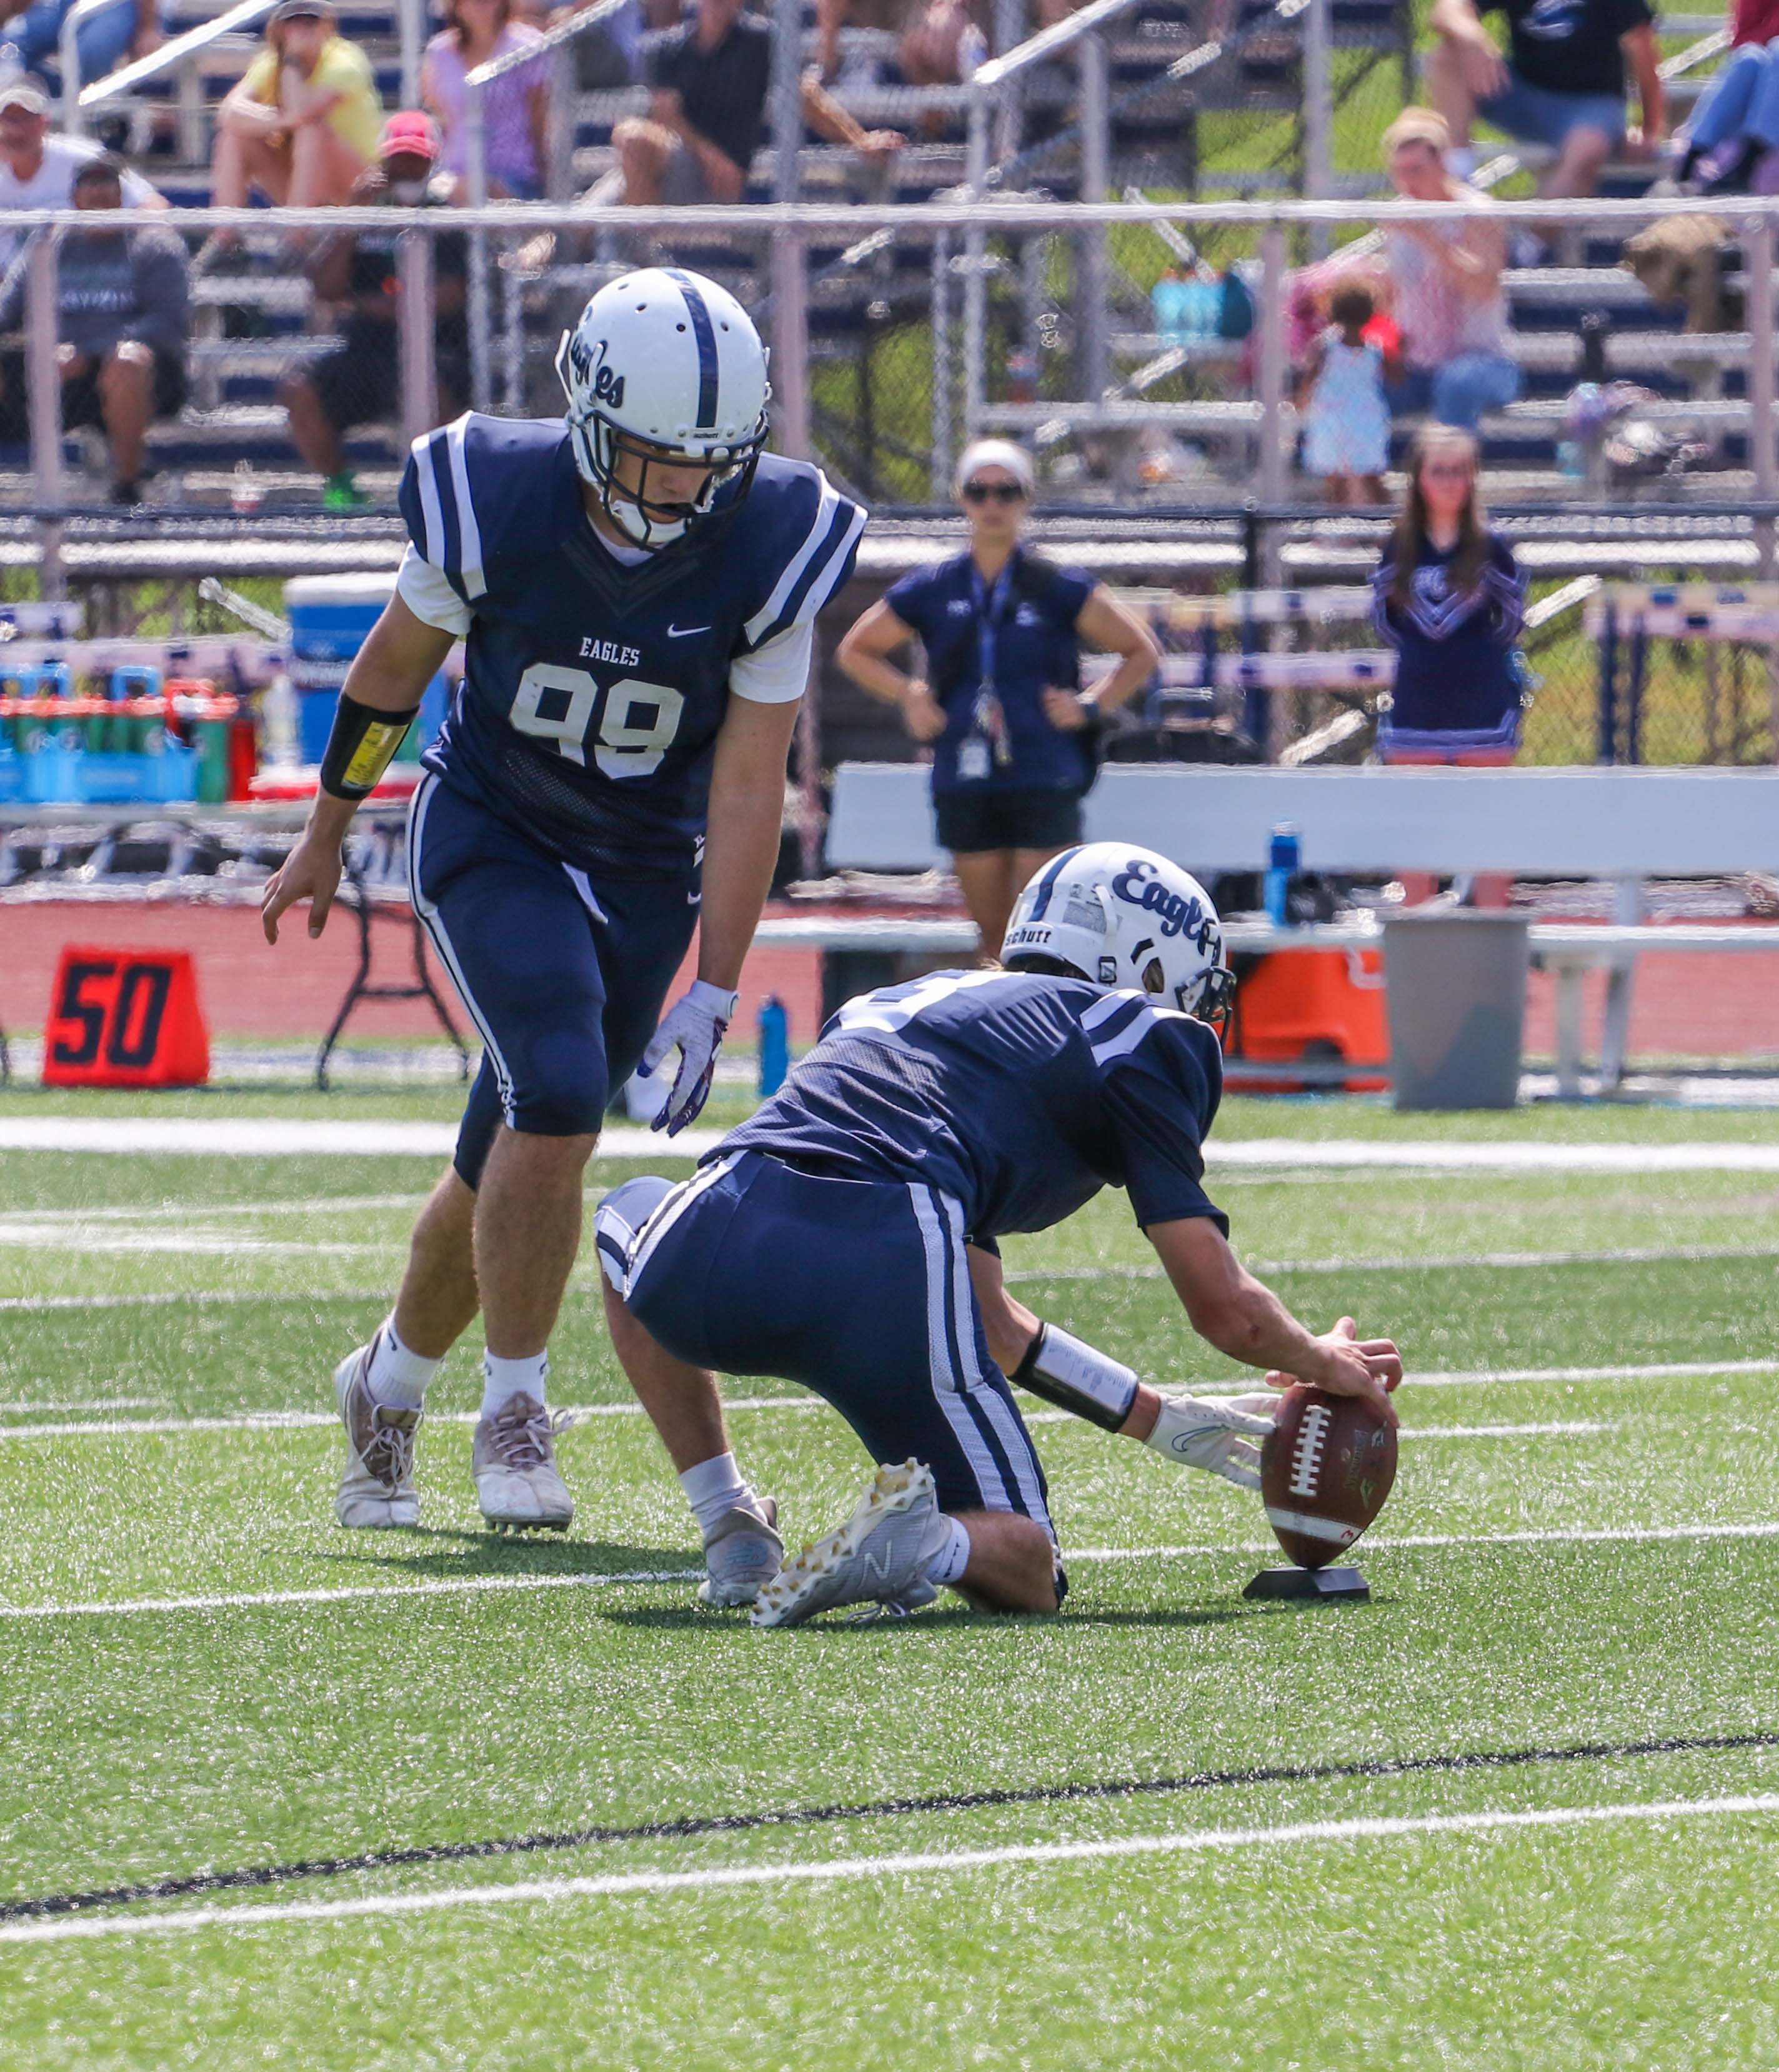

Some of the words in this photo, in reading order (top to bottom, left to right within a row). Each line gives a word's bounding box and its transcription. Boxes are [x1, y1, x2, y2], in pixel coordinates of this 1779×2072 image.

[579, 637, 640, 666] EAGLES
[509, 662, 684, 780] 99
[1005, 927, 1052, 946] schutt
[1113, 859, 1221, 966] Eagl
[55, 963, 171, 1066] 50
